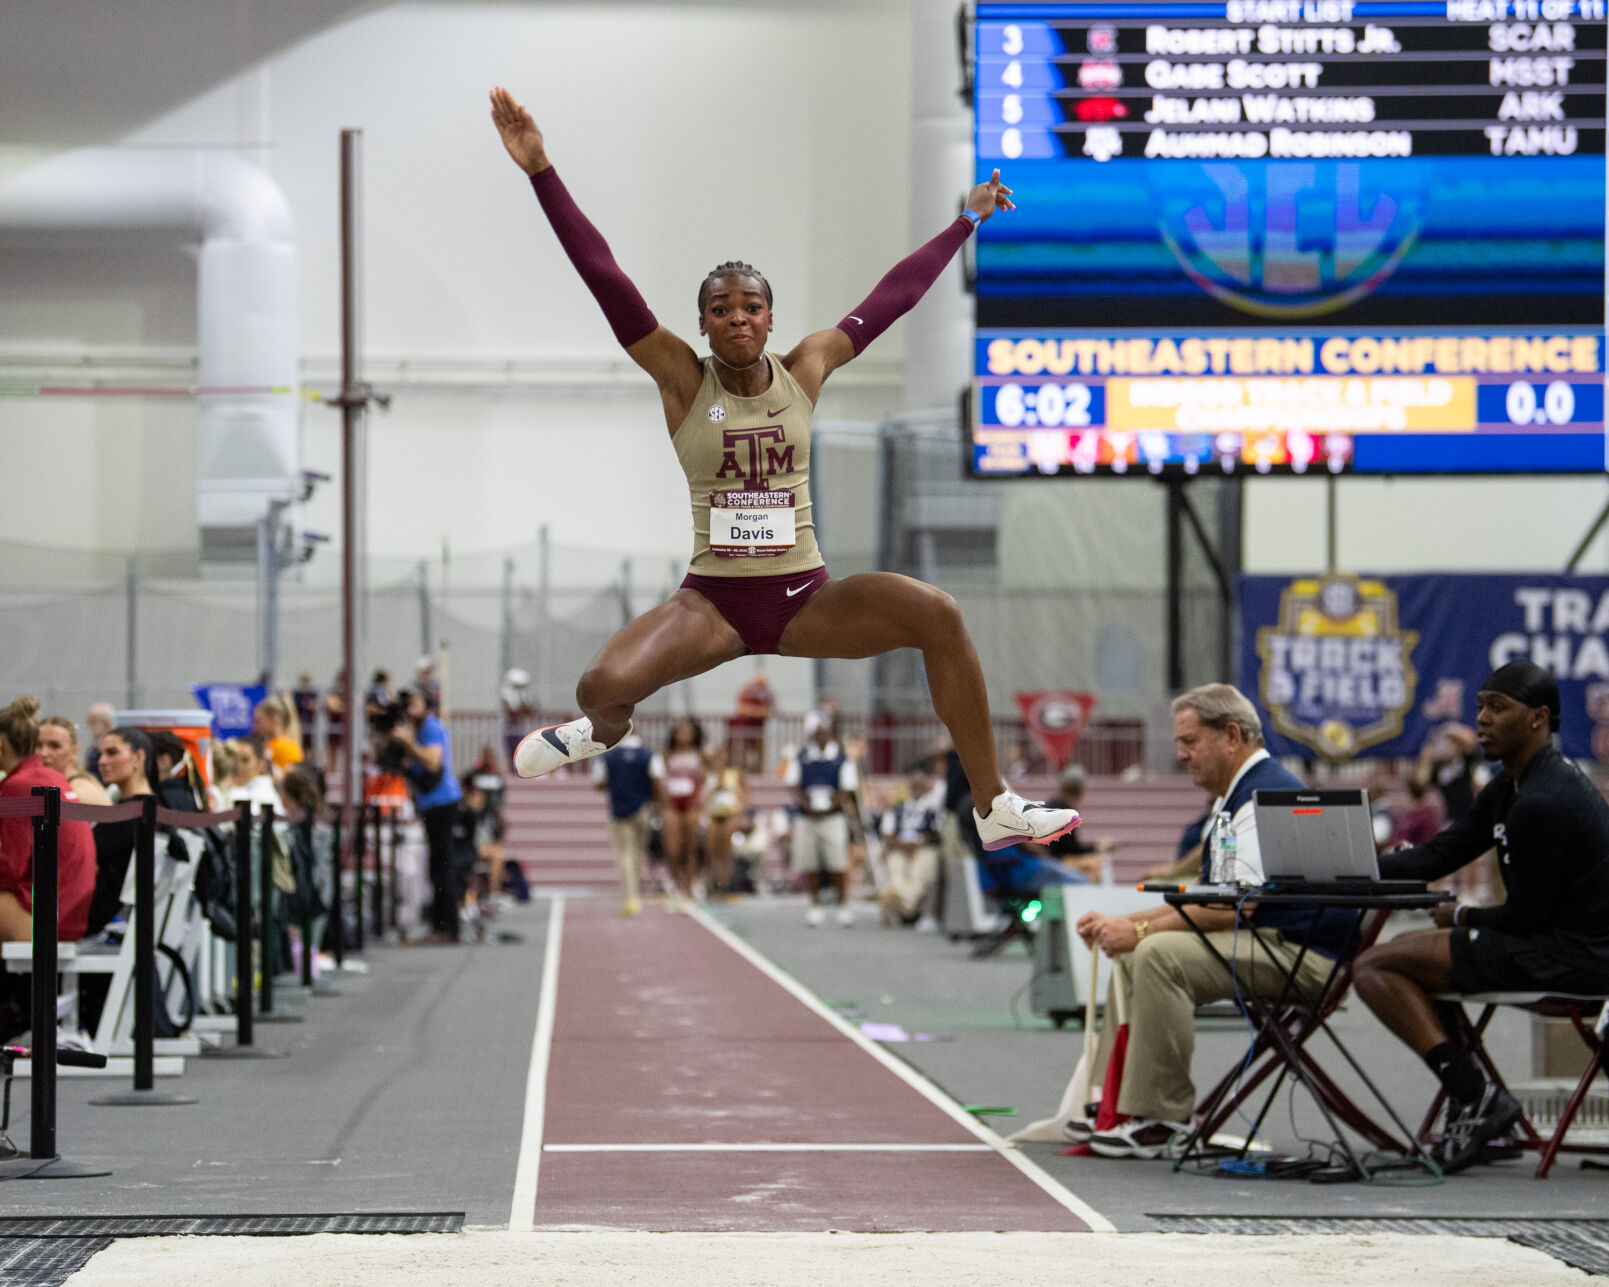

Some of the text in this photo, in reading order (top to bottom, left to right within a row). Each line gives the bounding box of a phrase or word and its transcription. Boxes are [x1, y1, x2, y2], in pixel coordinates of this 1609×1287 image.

[1226, 0, 1355, 23] START LIST
[1002, 24, 1024, 56] 3
[1488, 22, 1576, 52] SCAR
[1001, 59, 1024, 89] 4
[1489, 56, 1576, 87] MSST
[1002, 93, 1024, 124] 5
[1497, 90, 1566, 121] ARK
[1001, 127, 1024, 159] 6
[1483, 124, 1578, 156] TAMU
[987, 336, 1600, 374] SOUTHEASTERN CONFERENCE
[709, 406, 725, 422] SEC
[995, 382, 1091, 427] 6:02
[1506, 380, 1575, 426] 0.0
[735, 513, 769, 522] Morgan
[730, 527, 774, 540] Davis
[1269, 634, 1402, 672] TRACK
[1299, 669, 1407, 707] FIELD
